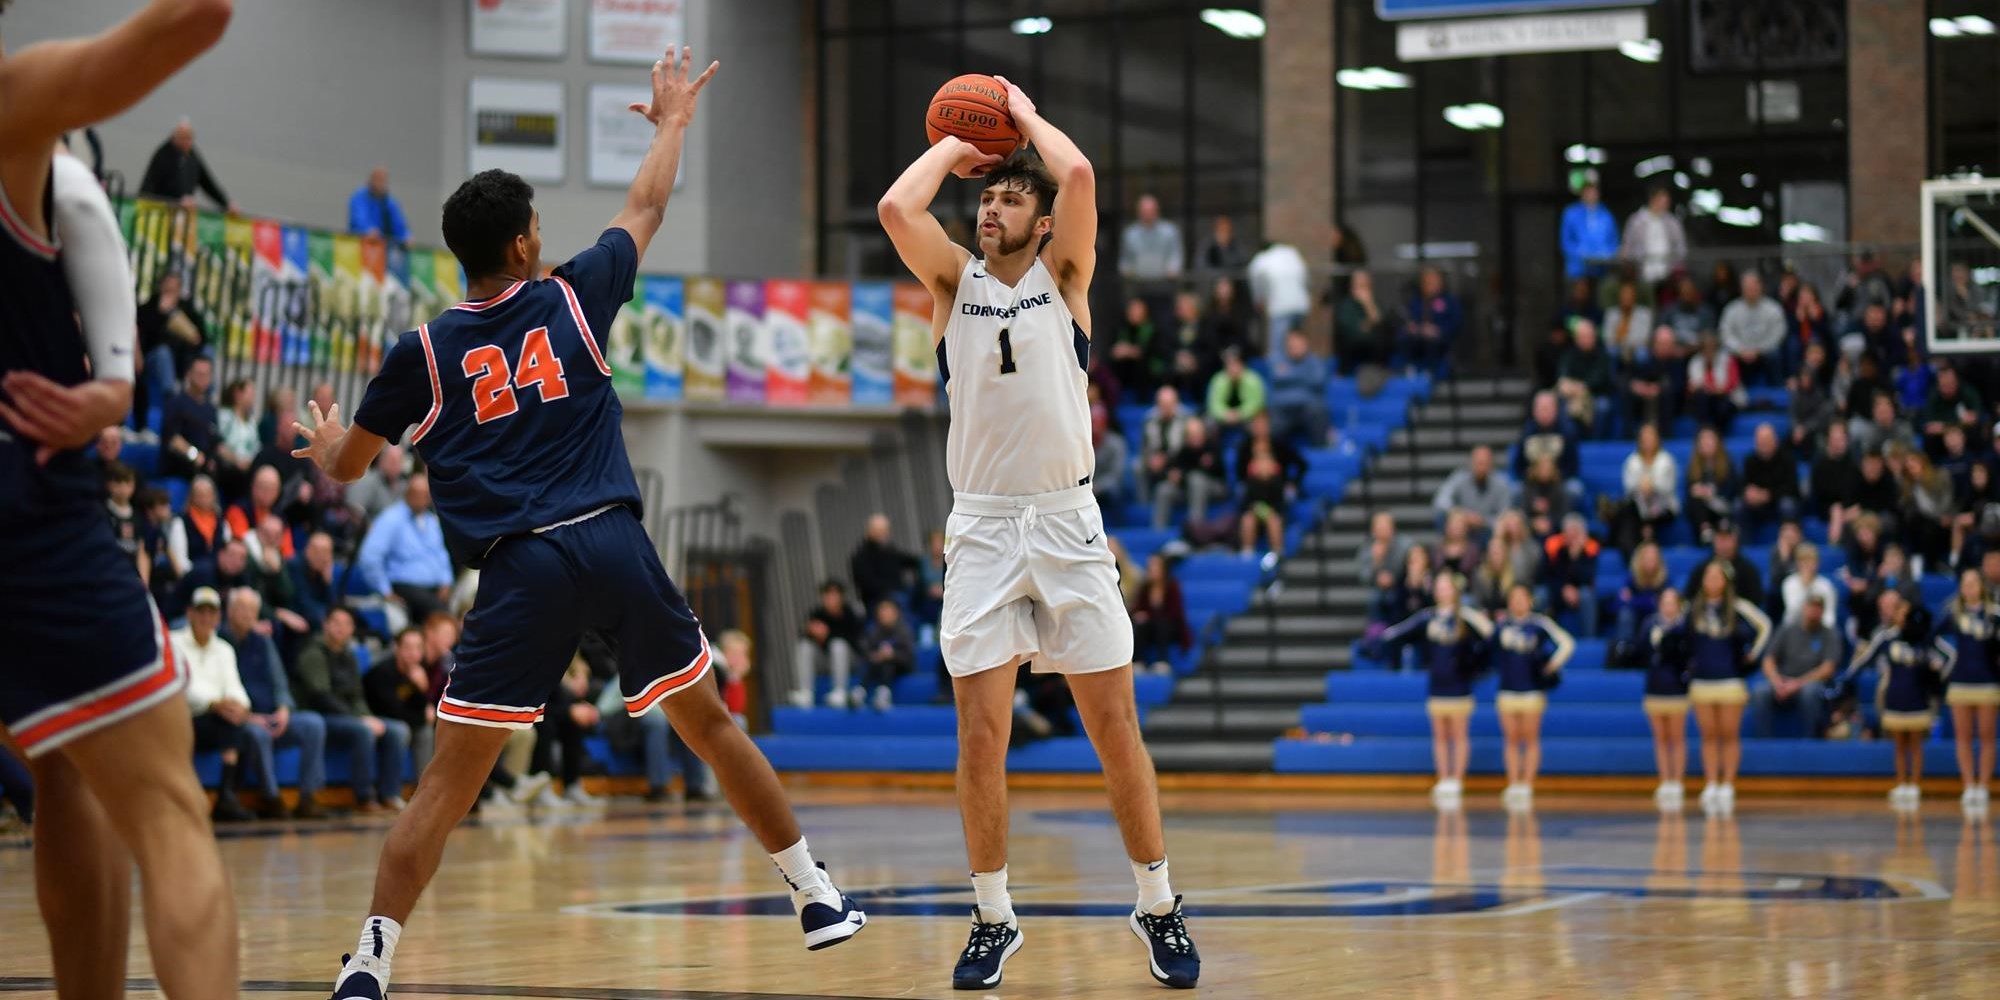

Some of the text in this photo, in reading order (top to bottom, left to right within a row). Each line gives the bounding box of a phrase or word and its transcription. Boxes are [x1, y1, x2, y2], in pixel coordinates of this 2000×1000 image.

[962, 292, 1051, 319] CORNERSONE
[461, 326, 569, 424] 24
[998, 328, 1016, 375] 1
